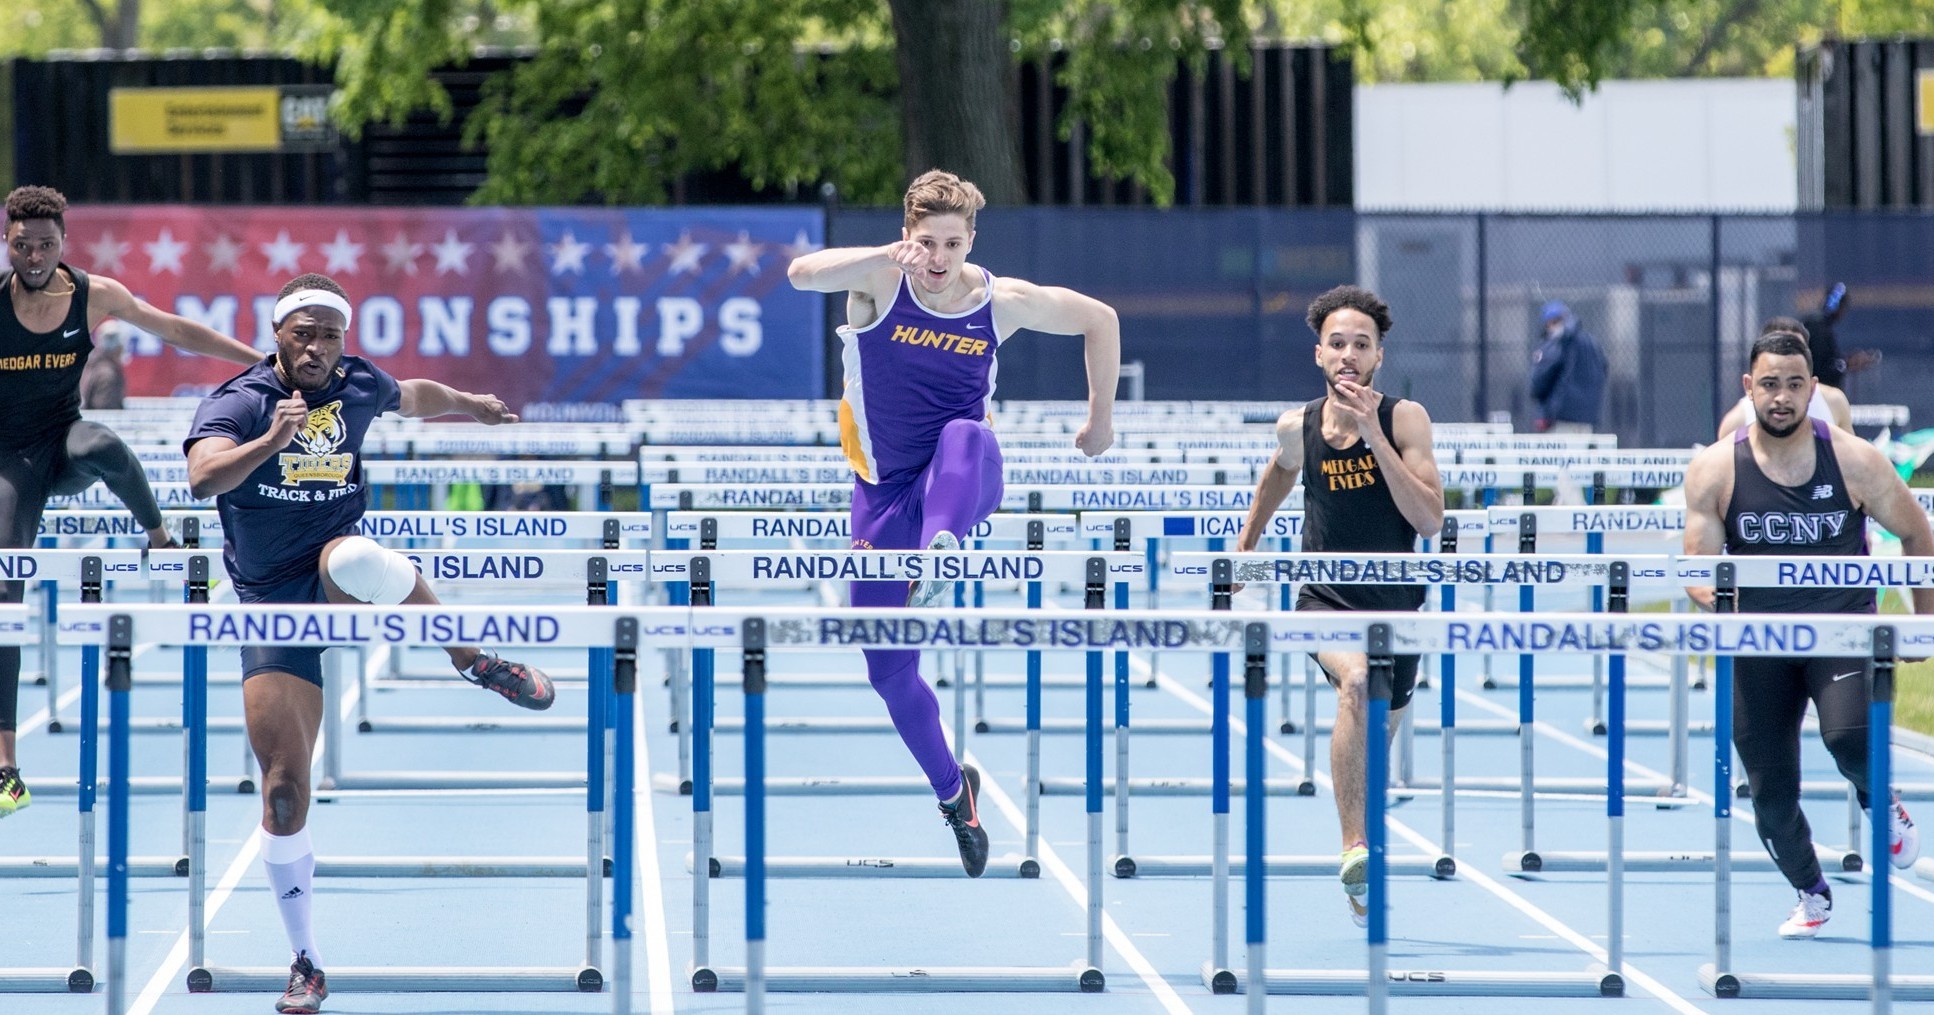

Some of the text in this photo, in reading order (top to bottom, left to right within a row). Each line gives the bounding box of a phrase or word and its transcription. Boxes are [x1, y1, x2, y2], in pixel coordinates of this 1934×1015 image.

[891, 325, 988, 356] HUNTER
[45, 353, 77, 368] EVERS
[1321, 454, 1378, 475] MEDGAR
[506, 467, 574, 483] ISLAND
[705, 467, 854, 484] RANDALL'S ISLA
[1010, 469, 1114, 484] RANDALL'S
[1121, 469, 1189, 484] ISLAND
[1329, 471, 1376, 491] EVERS
[1440, 470, 1497, 484] SLAND
[258, 483, 311, 502] TRACK
[314, 490, 326, 501] &
[1073, 490, 1191, 506] RANDALL'S
[55, 516, 146, 535] ISLAND
[361, 517, 650, 536] NDALL'S ISLAND UCS
[669, 518, 851, 537] UCS RANDAL
[1047, 525, 1074, 533] UCS
[1572, 513, 1685, 531] RANDALL
[1737, 510, 1848, 544] CCNY
[104, 563, 138, 572] UCS
[150, 563, 184, 571] UCS
[433, 555, 544, 579] ISLAND
[610, 563, 644, 573] UCS
[653, 556, 1144, 580] UCS RANDALL'S ISLAND UCS
[1174, 559, 1666, 584] UCS RANDALL'S ISLAND UCS
[1677, 562, 1934, 586] UCS RANDALL'
[59, 613, 686, 643] UCS RANDALL'S ISLAND UCS
[691, 618, 1316, 648] UCS RANDALL'S ISLAND UCS
[1320, 622, 1934, 652] UCS RANDALL'S ISLAND UC
